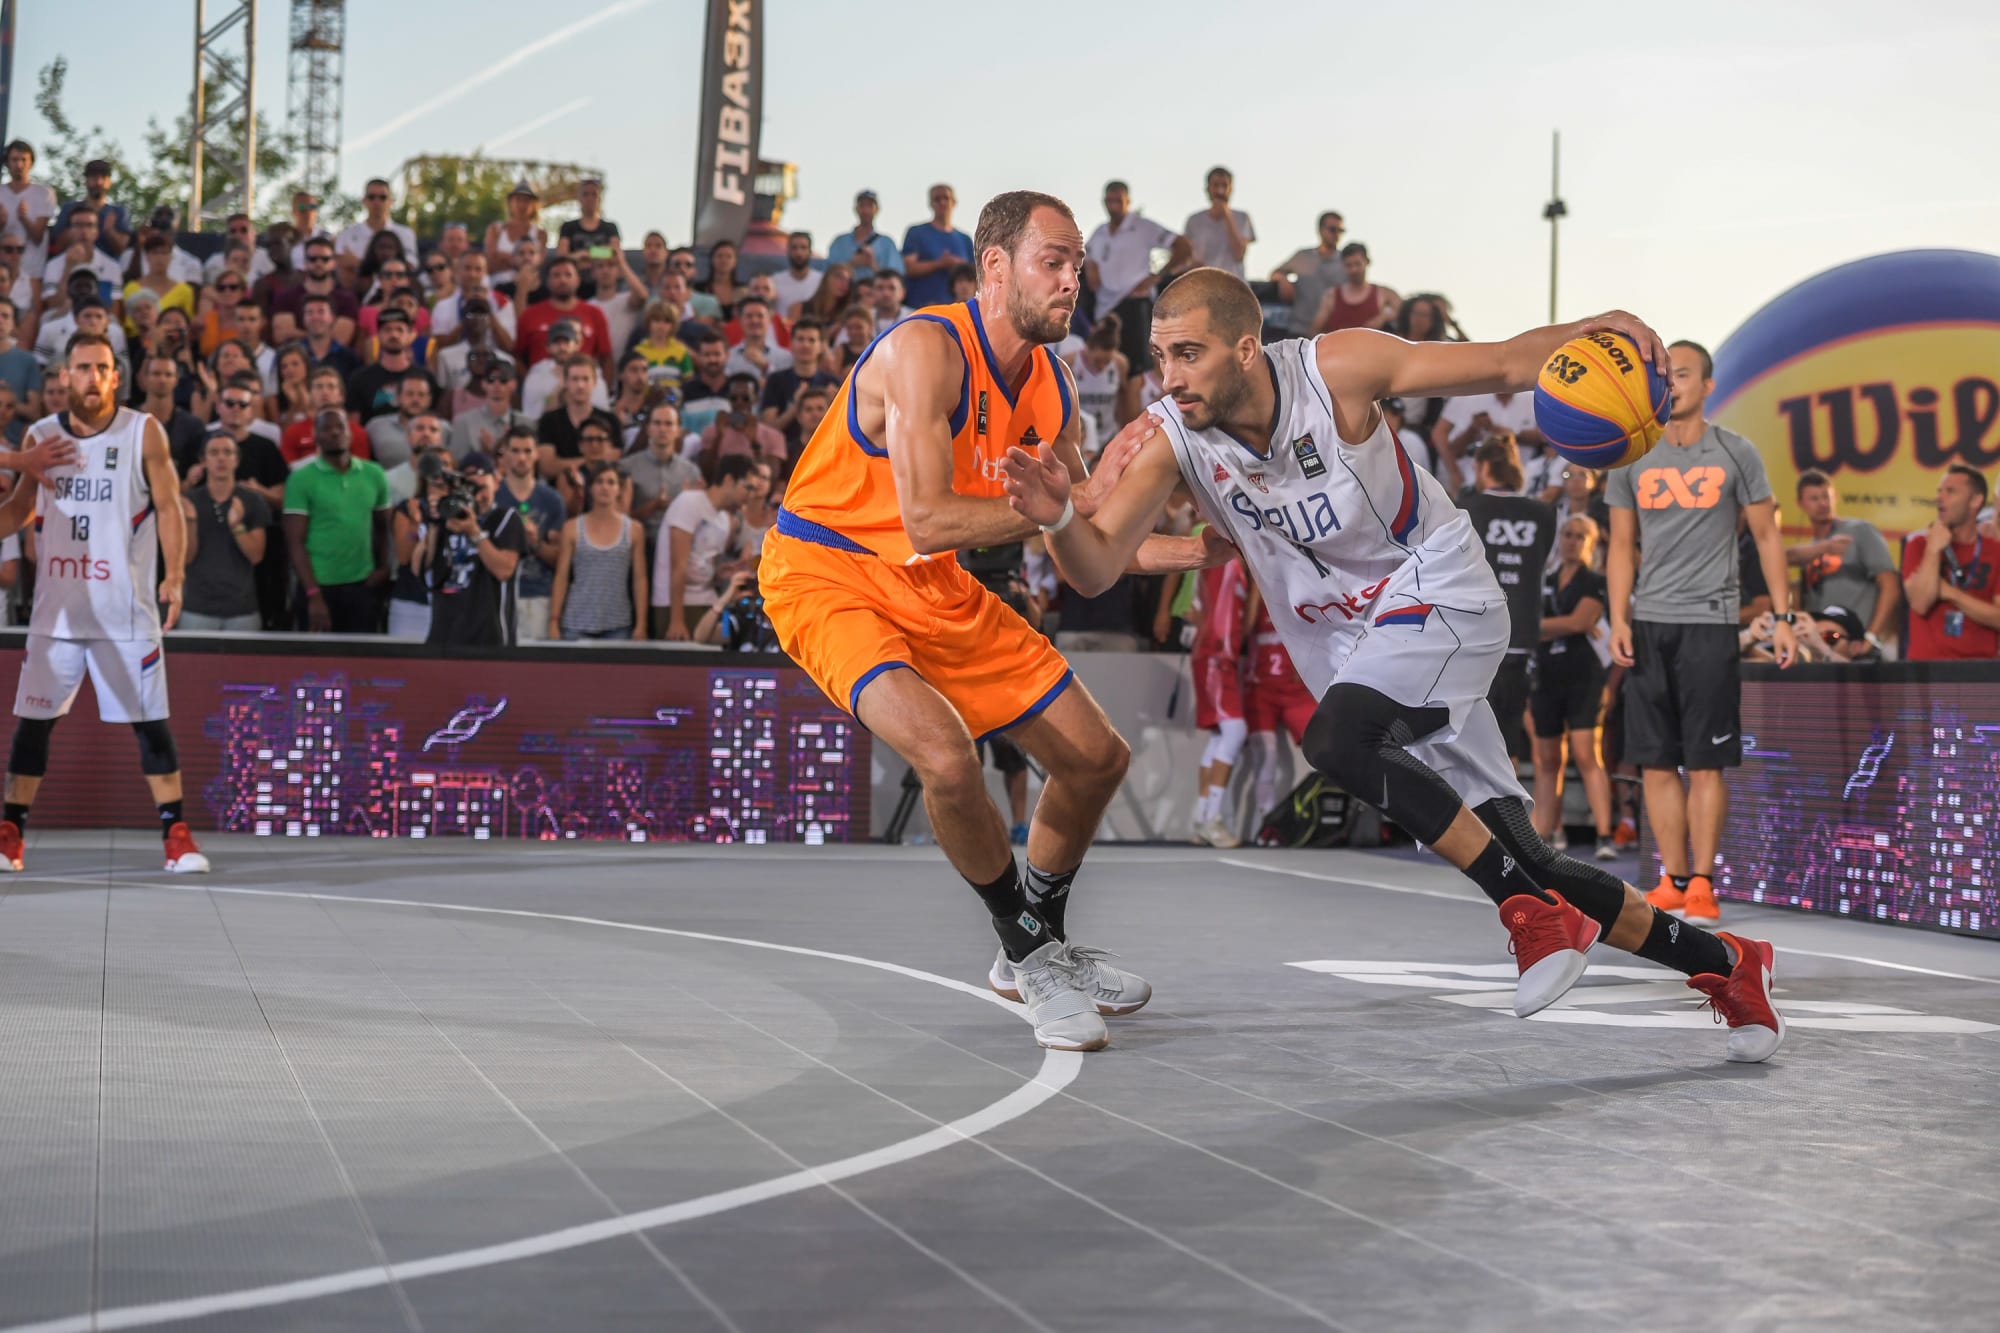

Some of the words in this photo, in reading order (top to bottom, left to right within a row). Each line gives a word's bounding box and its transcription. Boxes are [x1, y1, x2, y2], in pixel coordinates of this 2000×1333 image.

[1303, 457, 1320, 469] FIBA
[70, 515, 90, 541] 13
[49, 554, 111, 581] mts
